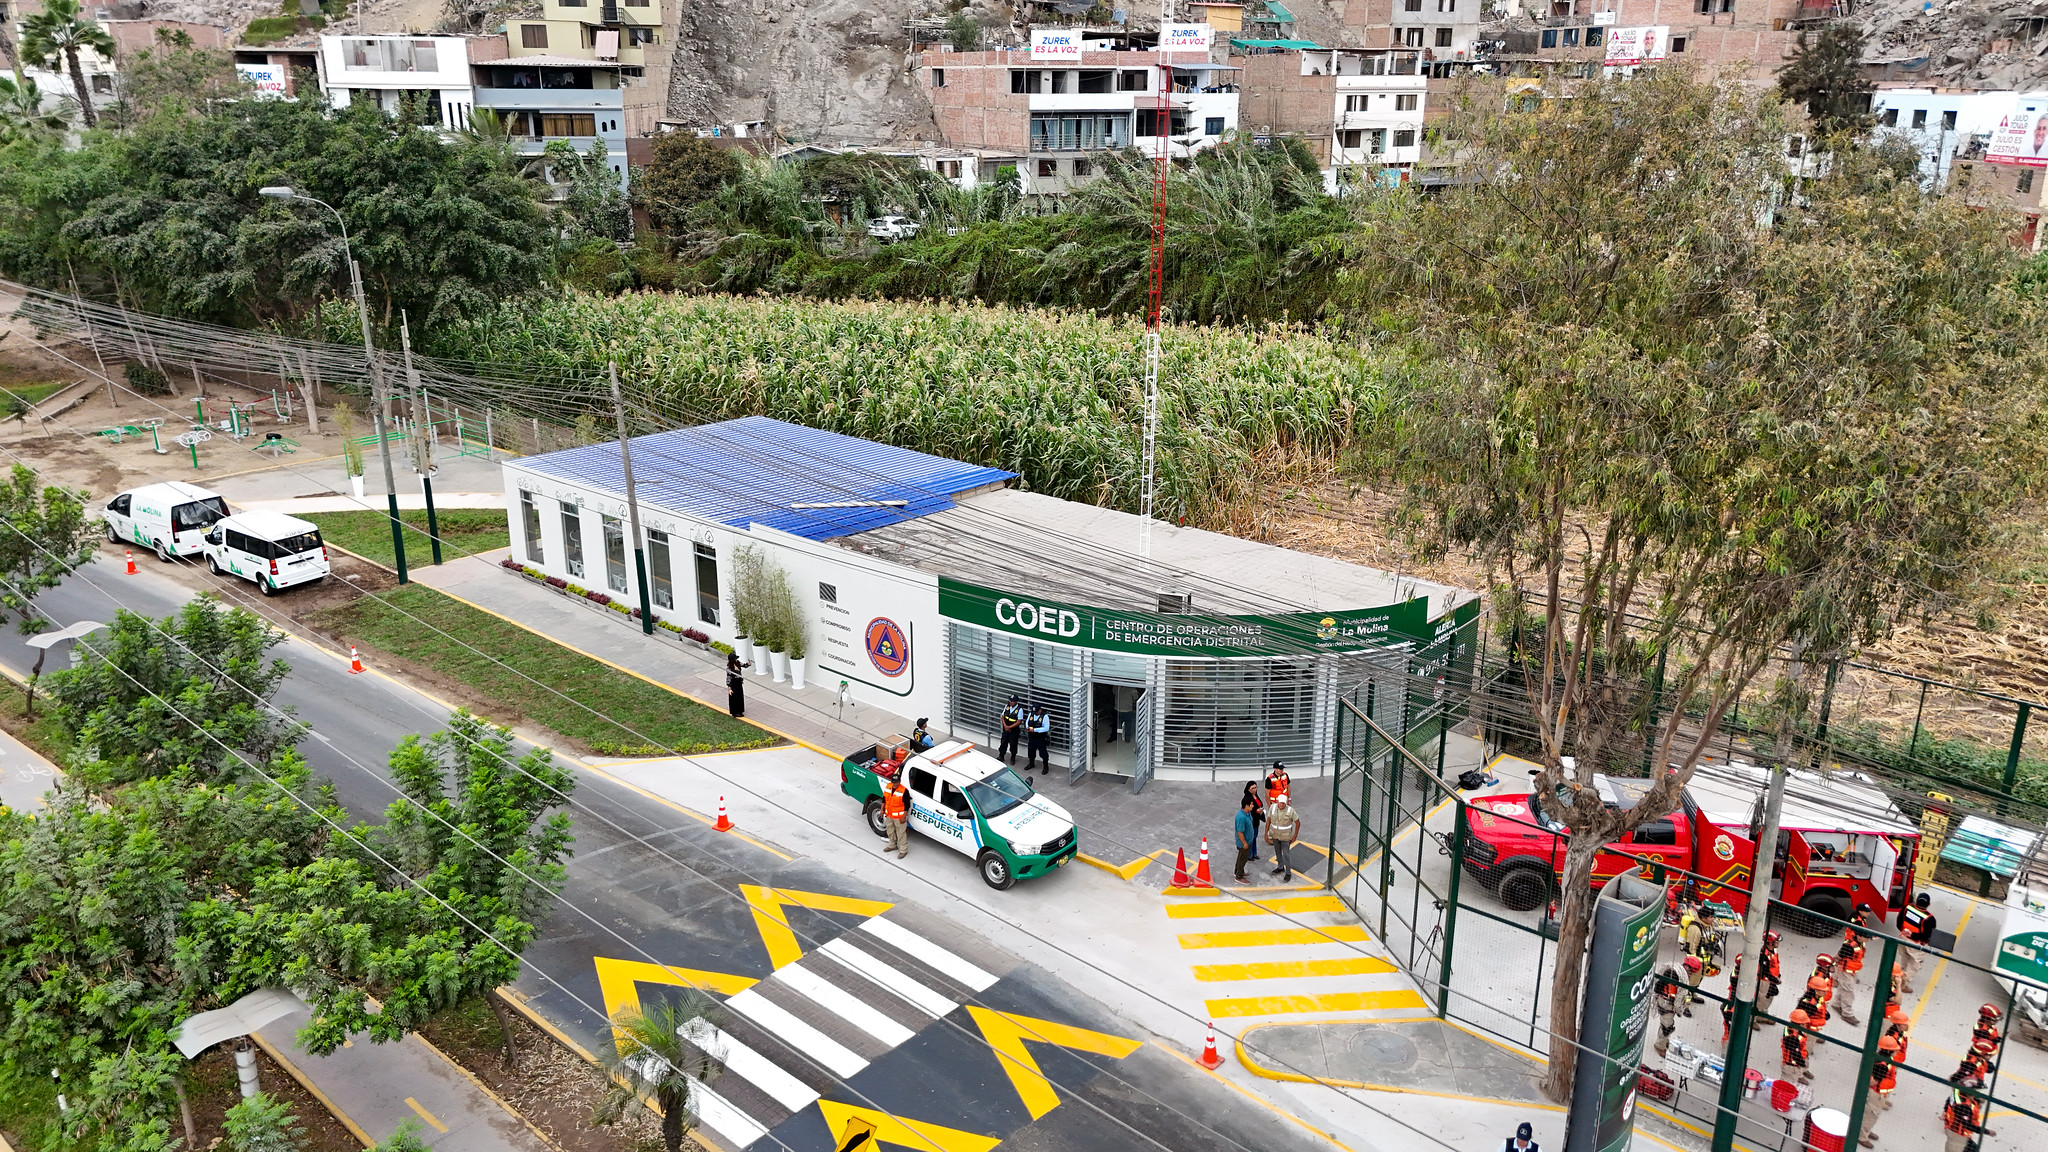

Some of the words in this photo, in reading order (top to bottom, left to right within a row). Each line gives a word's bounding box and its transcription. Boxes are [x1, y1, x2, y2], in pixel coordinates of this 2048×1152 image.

[1042, 36, 1071, 45] ZUREK
[1172, 29, 1199, 38] ZUREK
[1060, 46, 1078, 54] VOZ
[265, 82, 281, 91] VOZ
[136, 503, 142, 511] LA
[142, 506, 162, 518] MOLINA
[995, 598, 1081, 639] COED
[1106, 619, 1153, 633] CENTRO
[1157, 624, 1173, 634] DE
[1176, 624, 1262, 635] OPERACIONES
[1342, 627, 1354, 637] La
[1357, 622, 1389, 636] Molina
[1105, 630, 1121, 641] DE
[1124, 632, 1203, 647] EMERGENCIA
[1206, 636, 1265, 648] DISTRITAL
[910, 808, 964, 841] RESPUESTA
